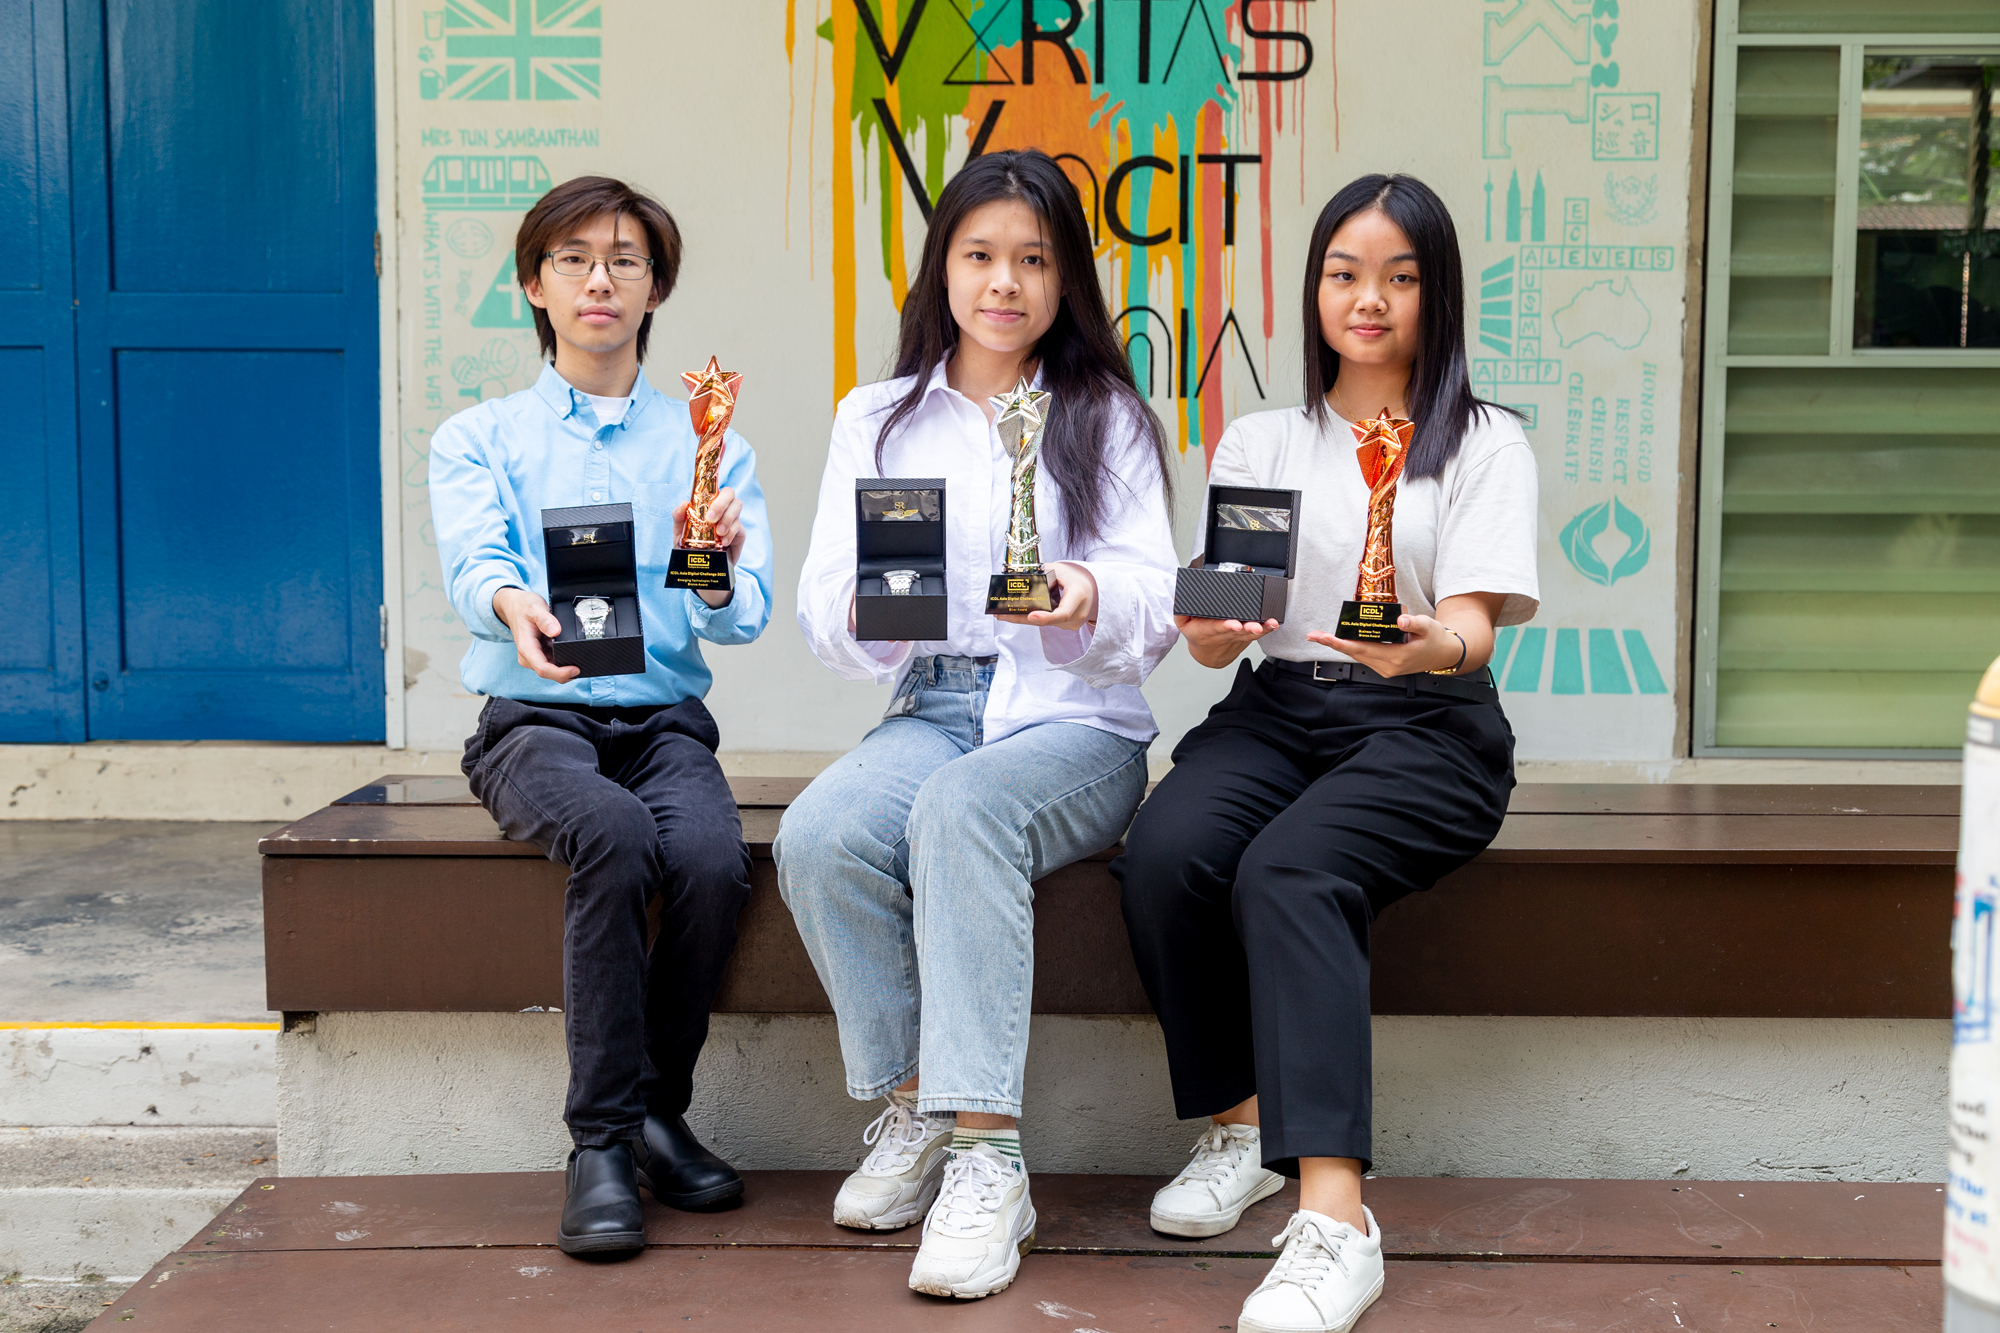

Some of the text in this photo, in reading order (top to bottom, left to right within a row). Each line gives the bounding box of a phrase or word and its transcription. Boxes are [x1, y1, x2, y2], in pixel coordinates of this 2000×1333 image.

[458, 128, 489, 148] TUN
[494, 127, 600, 149] SAMBANTHAN
[423, 211, 442, 280] WHAT'S
[424, 284, 442, 330] WITH
[424, 336, 442, 369] THE
[1564, 371, 1584, 484] CELEBRATE
[1588, 396, 1607, 483] CHERISH
[1613, 397, 1631, 486] RESPECT
[1637, 361, 1658, 484] HONOR GOD
